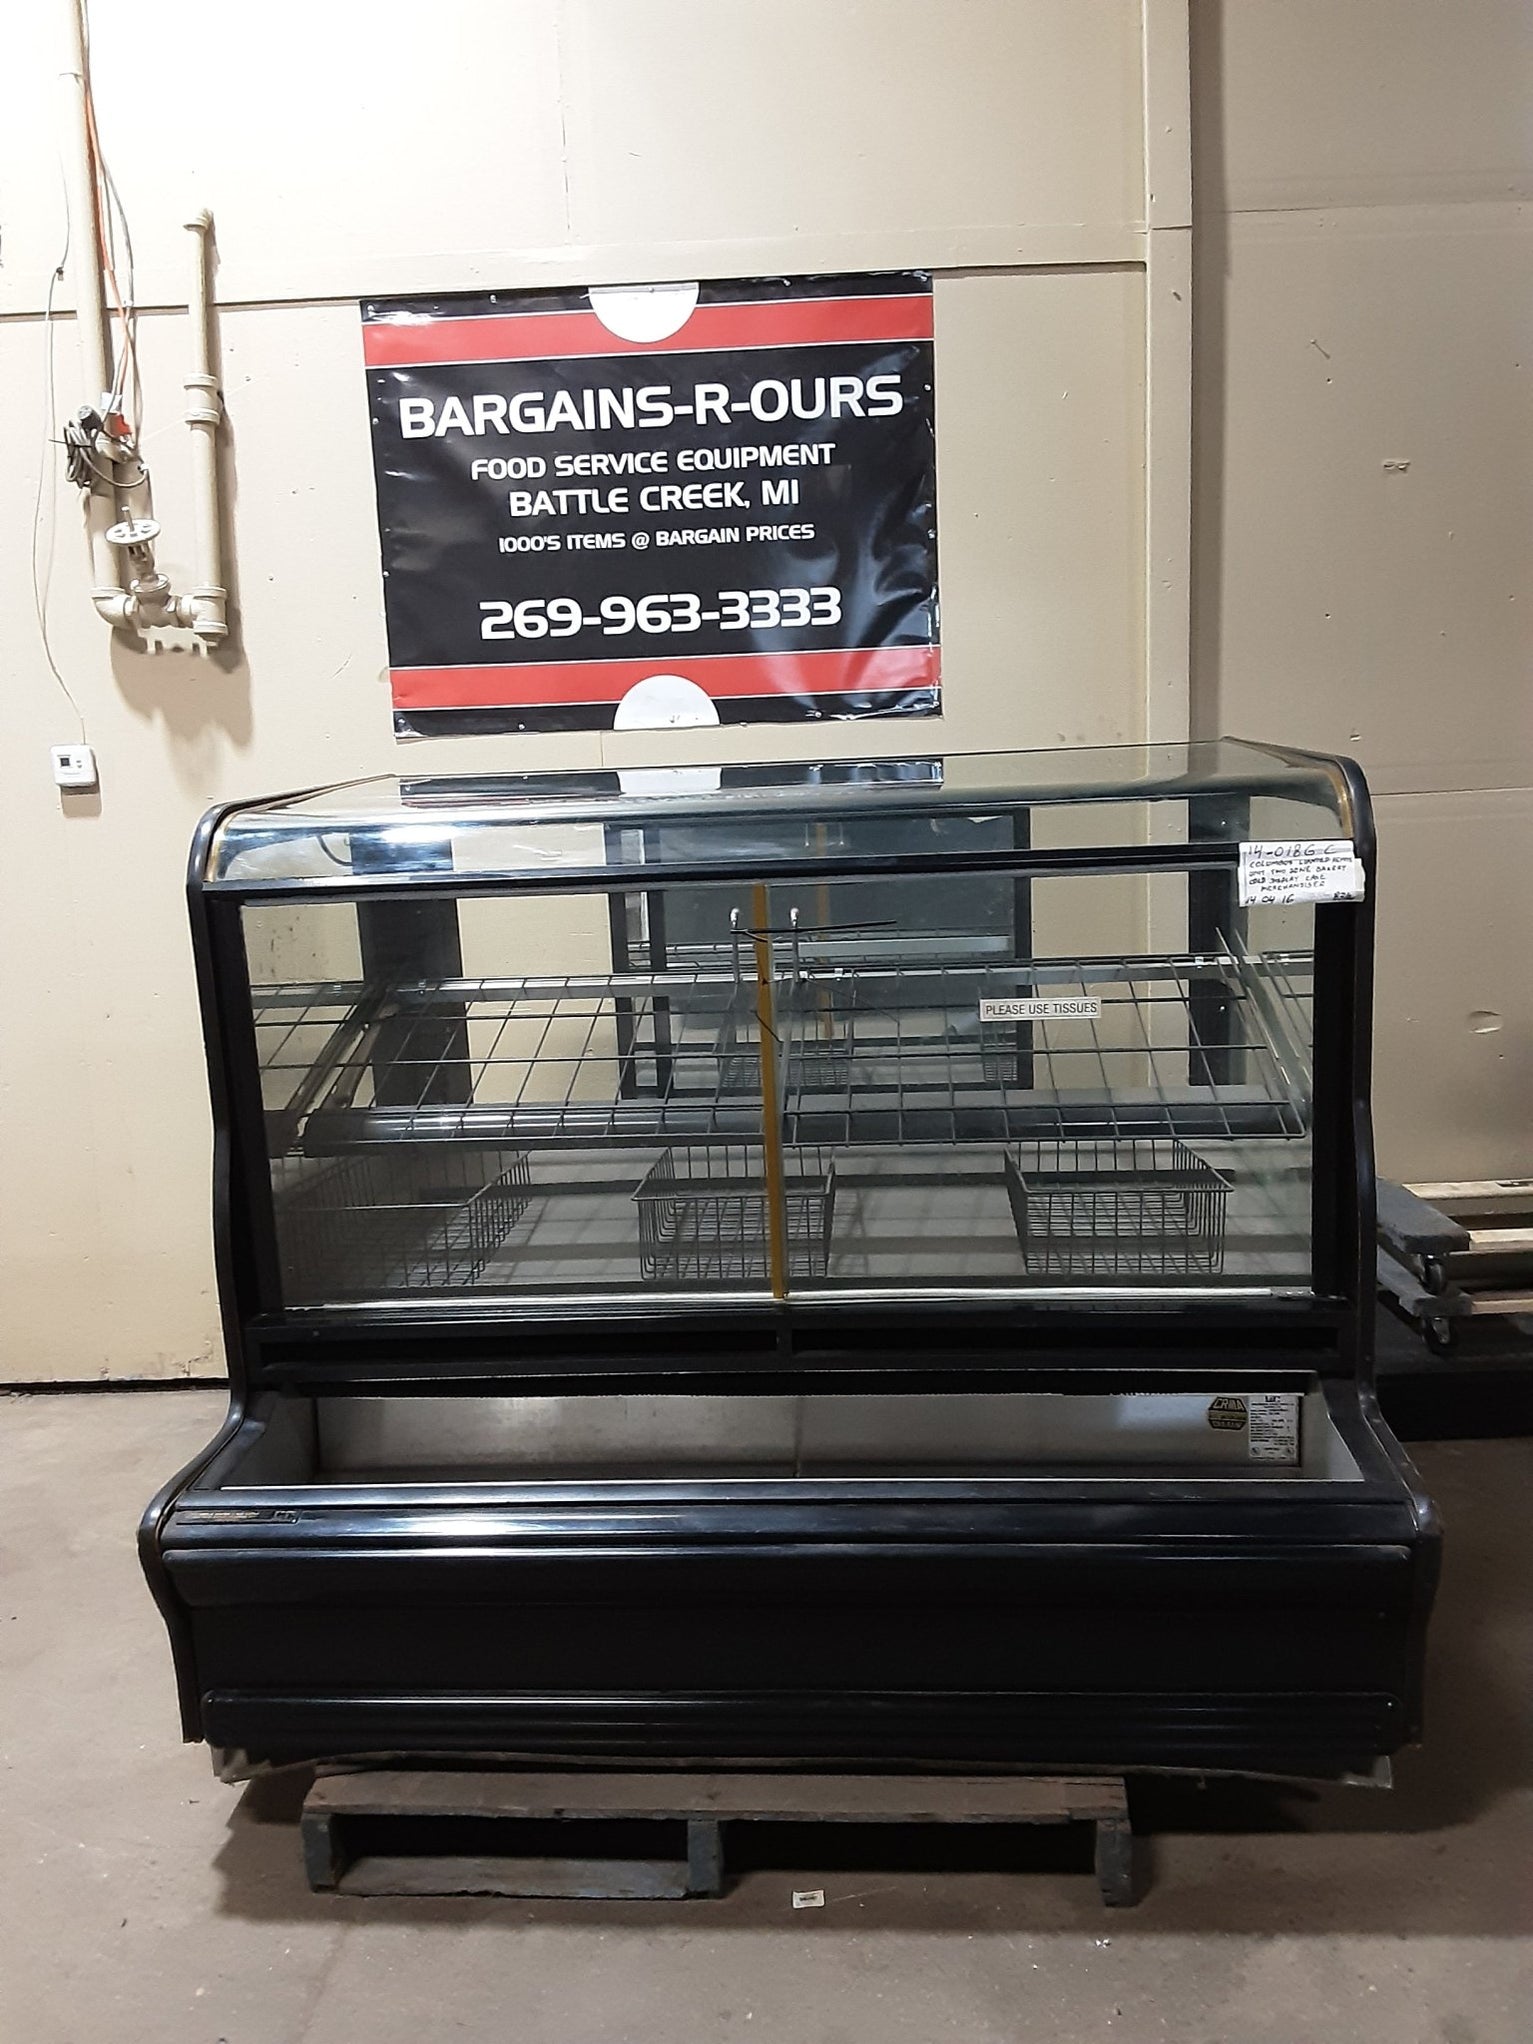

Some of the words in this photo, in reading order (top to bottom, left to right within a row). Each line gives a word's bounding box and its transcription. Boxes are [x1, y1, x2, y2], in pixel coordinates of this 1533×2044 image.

[399, 375, 904, 440] BARGAINS-R-OURS
[471, 456, 547, 481] FOOD
[554, 451, 668, 477] SERVICE
[677, 443, 836, 471] EQUIPMENT
[509, 488, 629, 517] BATTLE
[639, 482, 750, 511] CREEK,
[761, 479, 799, 506] MI
[499, 535, 561, 553] 1000'S
[566, 533, 625, 550] ITEMS
[631, 532, 650, 550] @
[655, 527, 739, 547] BARGAIN
[747, 523, 815, 542] PRICES
[479, 586, 842, 640] 269-963-3333
[985, 1004, 1025, 1015] PLEASE
[1028, 1003, 1050, 1015] USE
[1053, 1002, 1098, 1014] TISSUES
